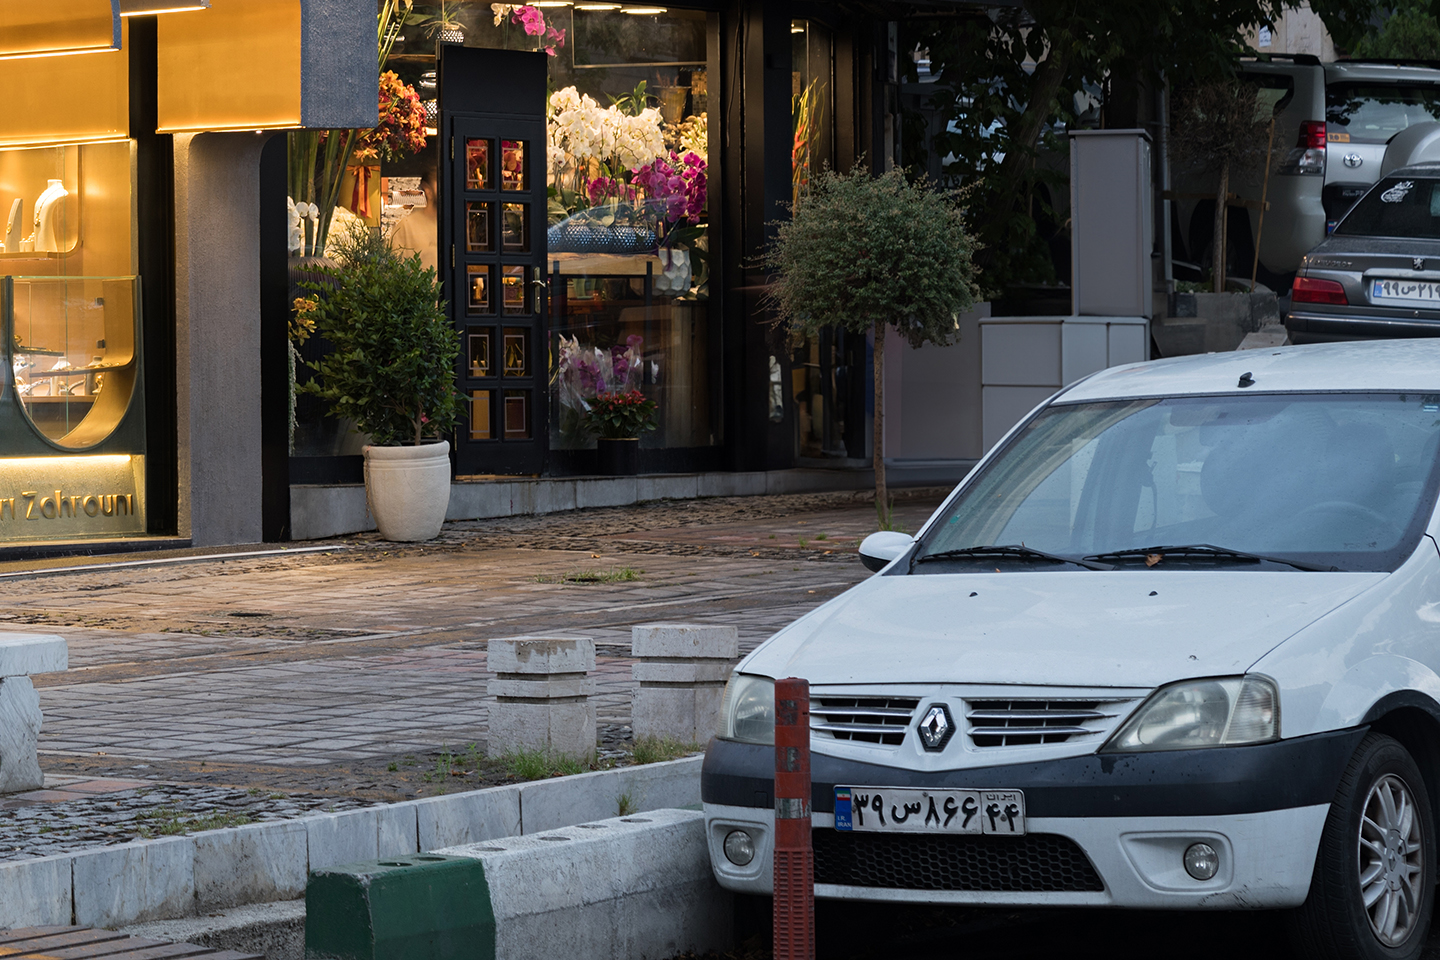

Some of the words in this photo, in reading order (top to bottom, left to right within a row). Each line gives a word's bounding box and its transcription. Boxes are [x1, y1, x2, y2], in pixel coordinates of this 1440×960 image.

[21, 490, 134, 520] Zahrouni
[986, 793, 1017, 801] ایران
[985, 802, 1020, 832] ۴۴
